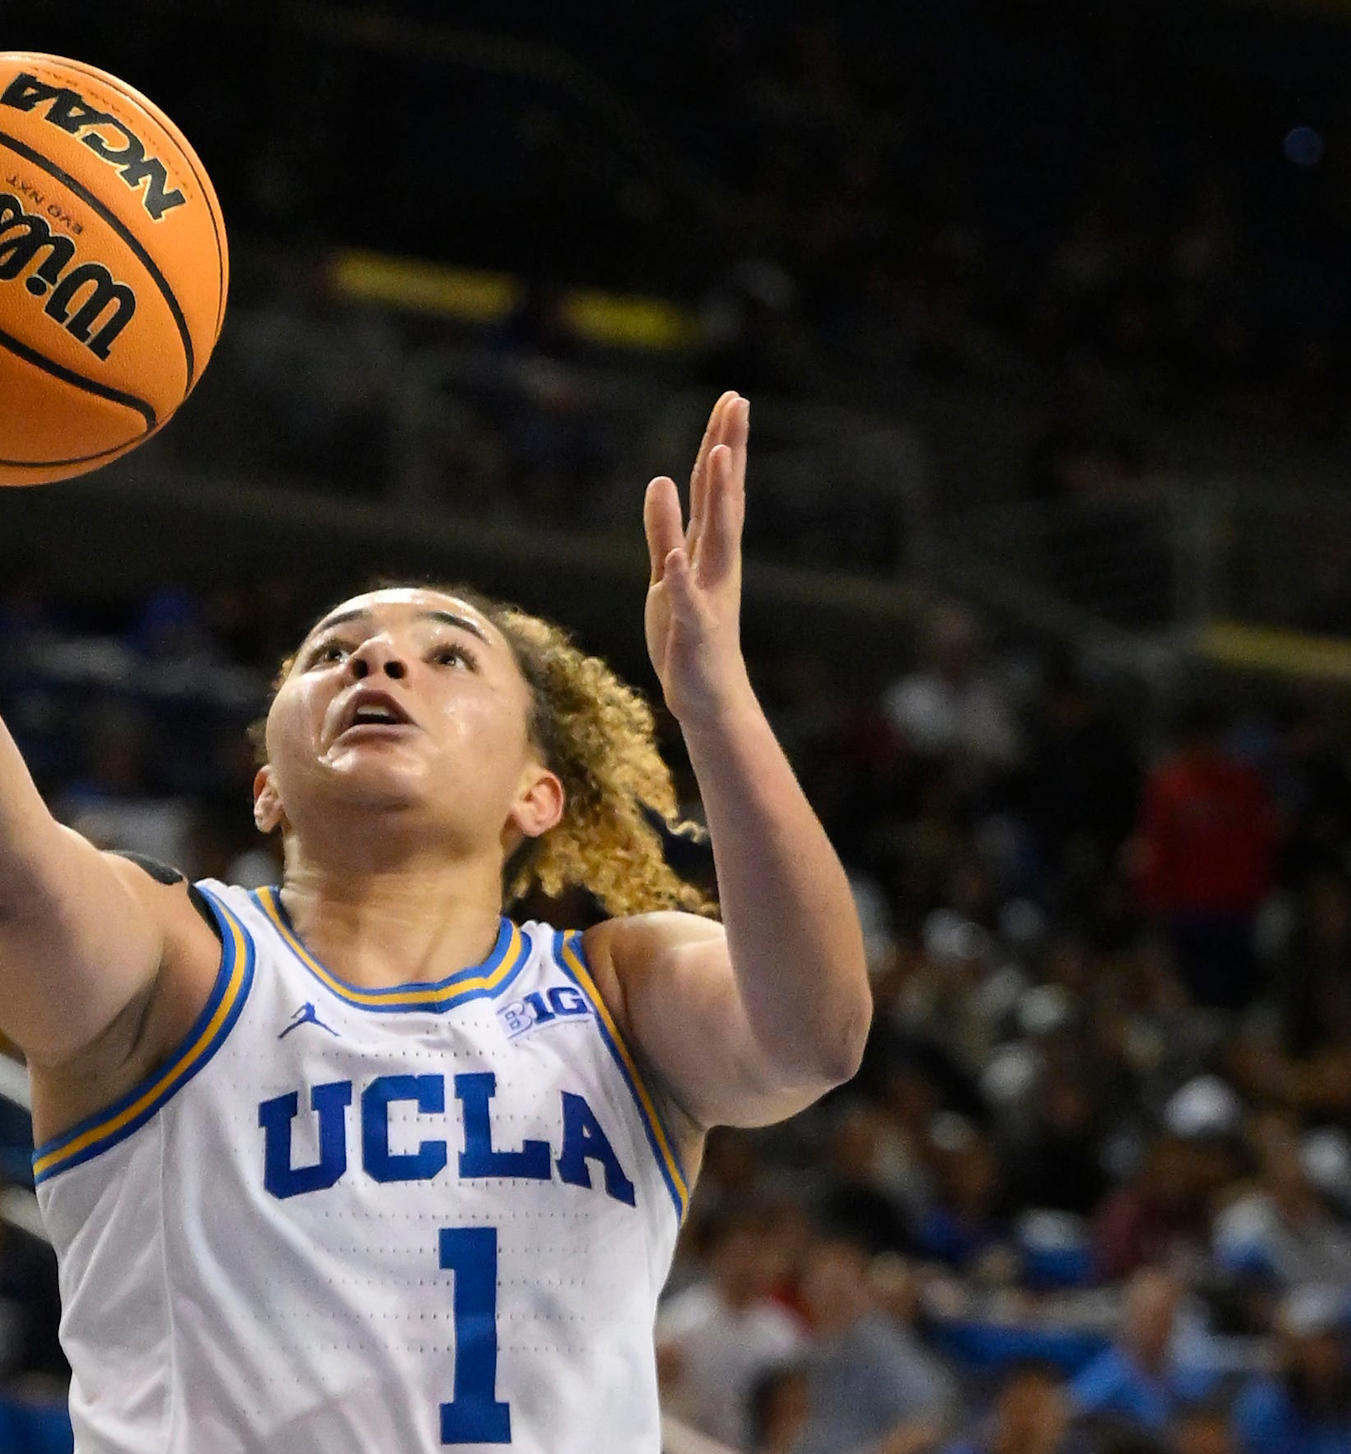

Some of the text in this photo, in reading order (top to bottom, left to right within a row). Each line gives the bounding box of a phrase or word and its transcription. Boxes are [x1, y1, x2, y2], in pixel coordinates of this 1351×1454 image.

[0, 72, 186, 220] NCAA
[6, 175, 83, 235] EVO NXT
[259, 1072, 635, 1207] UCLA
[438, 1227, 512, 1444] 1
